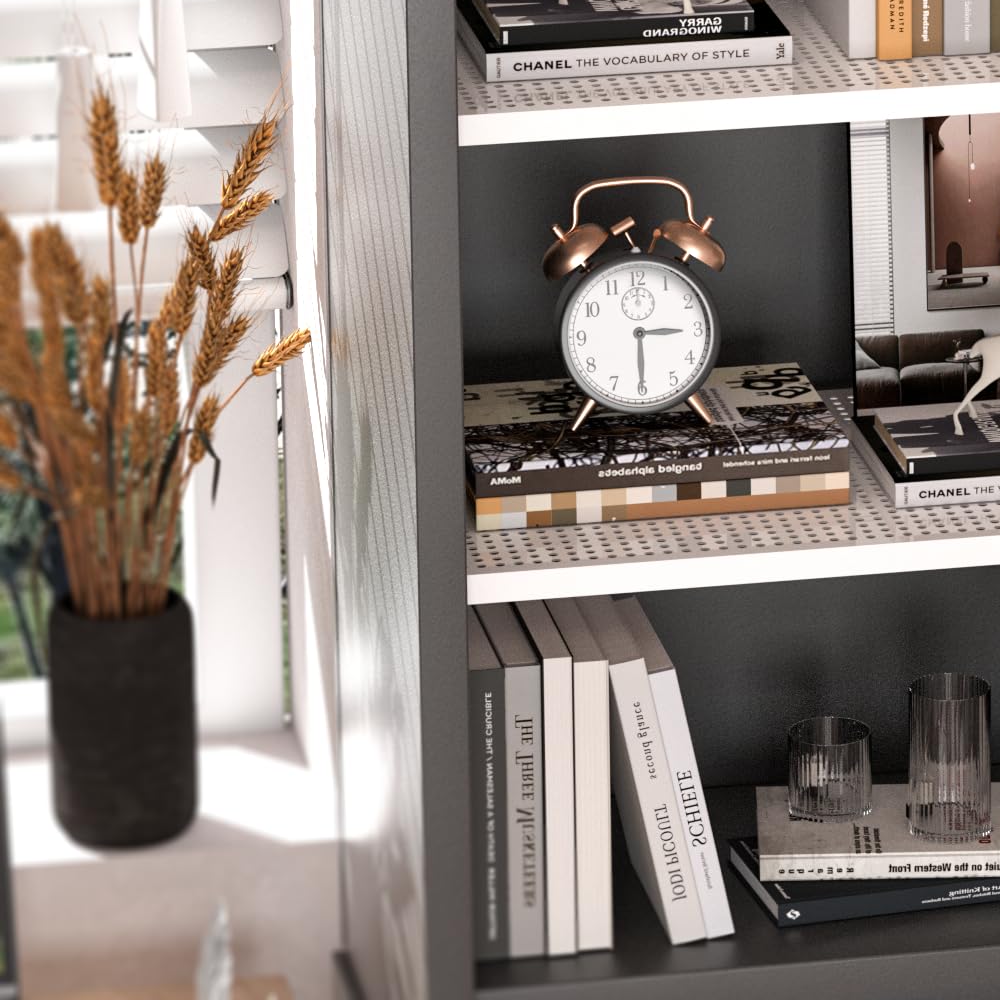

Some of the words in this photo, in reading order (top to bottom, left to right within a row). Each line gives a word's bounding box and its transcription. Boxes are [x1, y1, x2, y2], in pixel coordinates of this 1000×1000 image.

[776, 43, 785, 59] Yale
[513, 60, 572, 72] CHANEL
[576, 58, 599, 68] THE
[604, 53, 688, 66] VOCABULARY
[692, 52, 709, 61] OF
[712, 49, 750, 59] STYLE
[630, 272, 645, 286] 12
[662, 276, 668, 291] 1
[605, 280, 619, 295] 11
[684, 295, 694, 309] 2
[585, 303, 600, 317] 10
[694, 322, 703, 337] 3
[577, 331, 587, 346] 9
[587, 358, 597, 372] 8
[684, 351, 695, 365] 4
[609, 376, 619, 391] 7
[669, 371, 678, 387] 5
